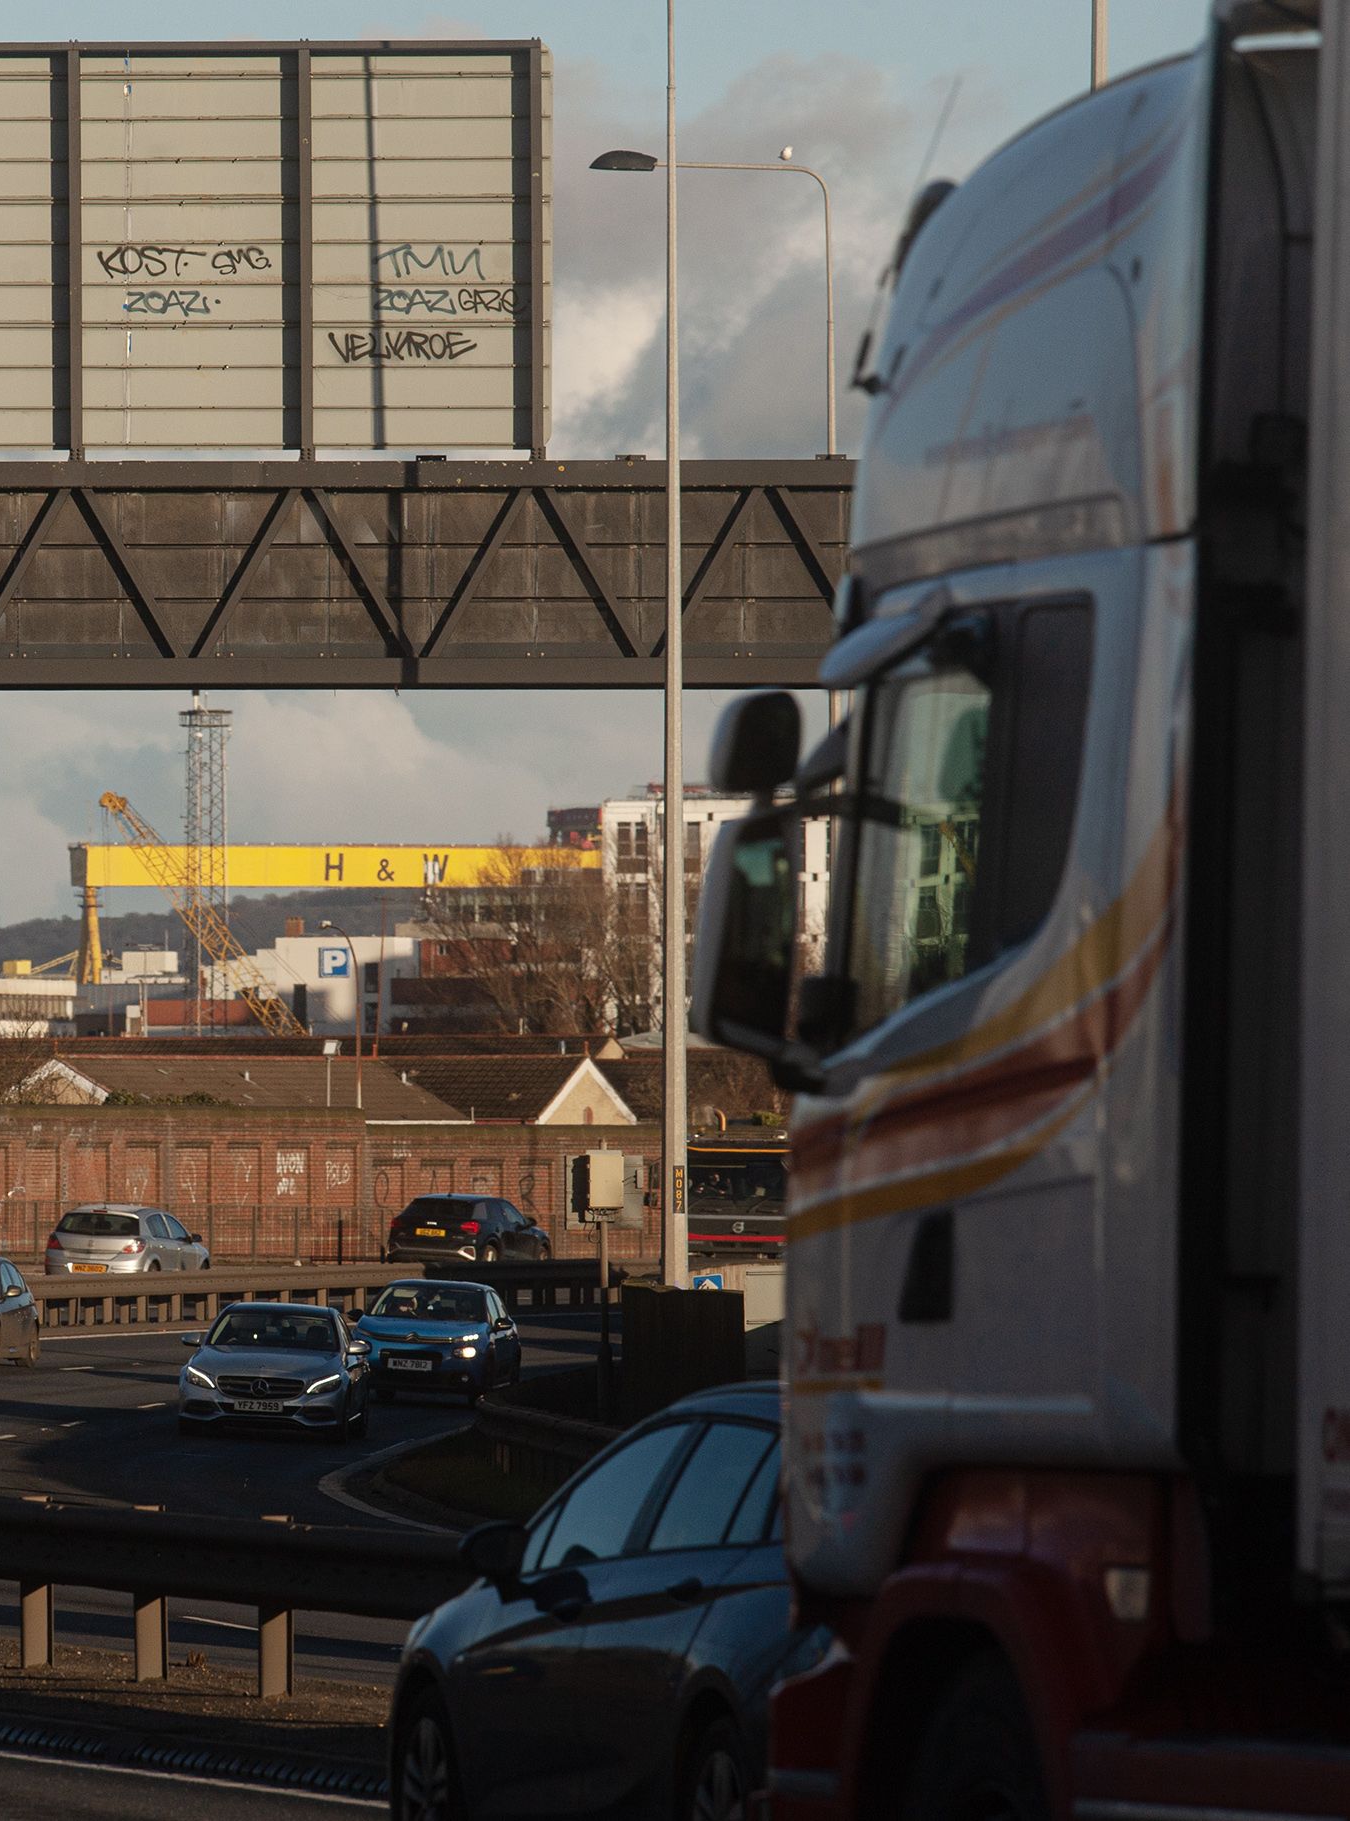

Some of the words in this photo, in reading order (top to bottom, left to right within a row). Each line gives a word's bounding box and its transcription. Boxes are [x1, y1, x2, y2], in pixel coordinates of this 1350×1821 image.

[325, 853, 344, 881] H
[377, 858, 394, 881] &
[423, 854, 449, 882] W
